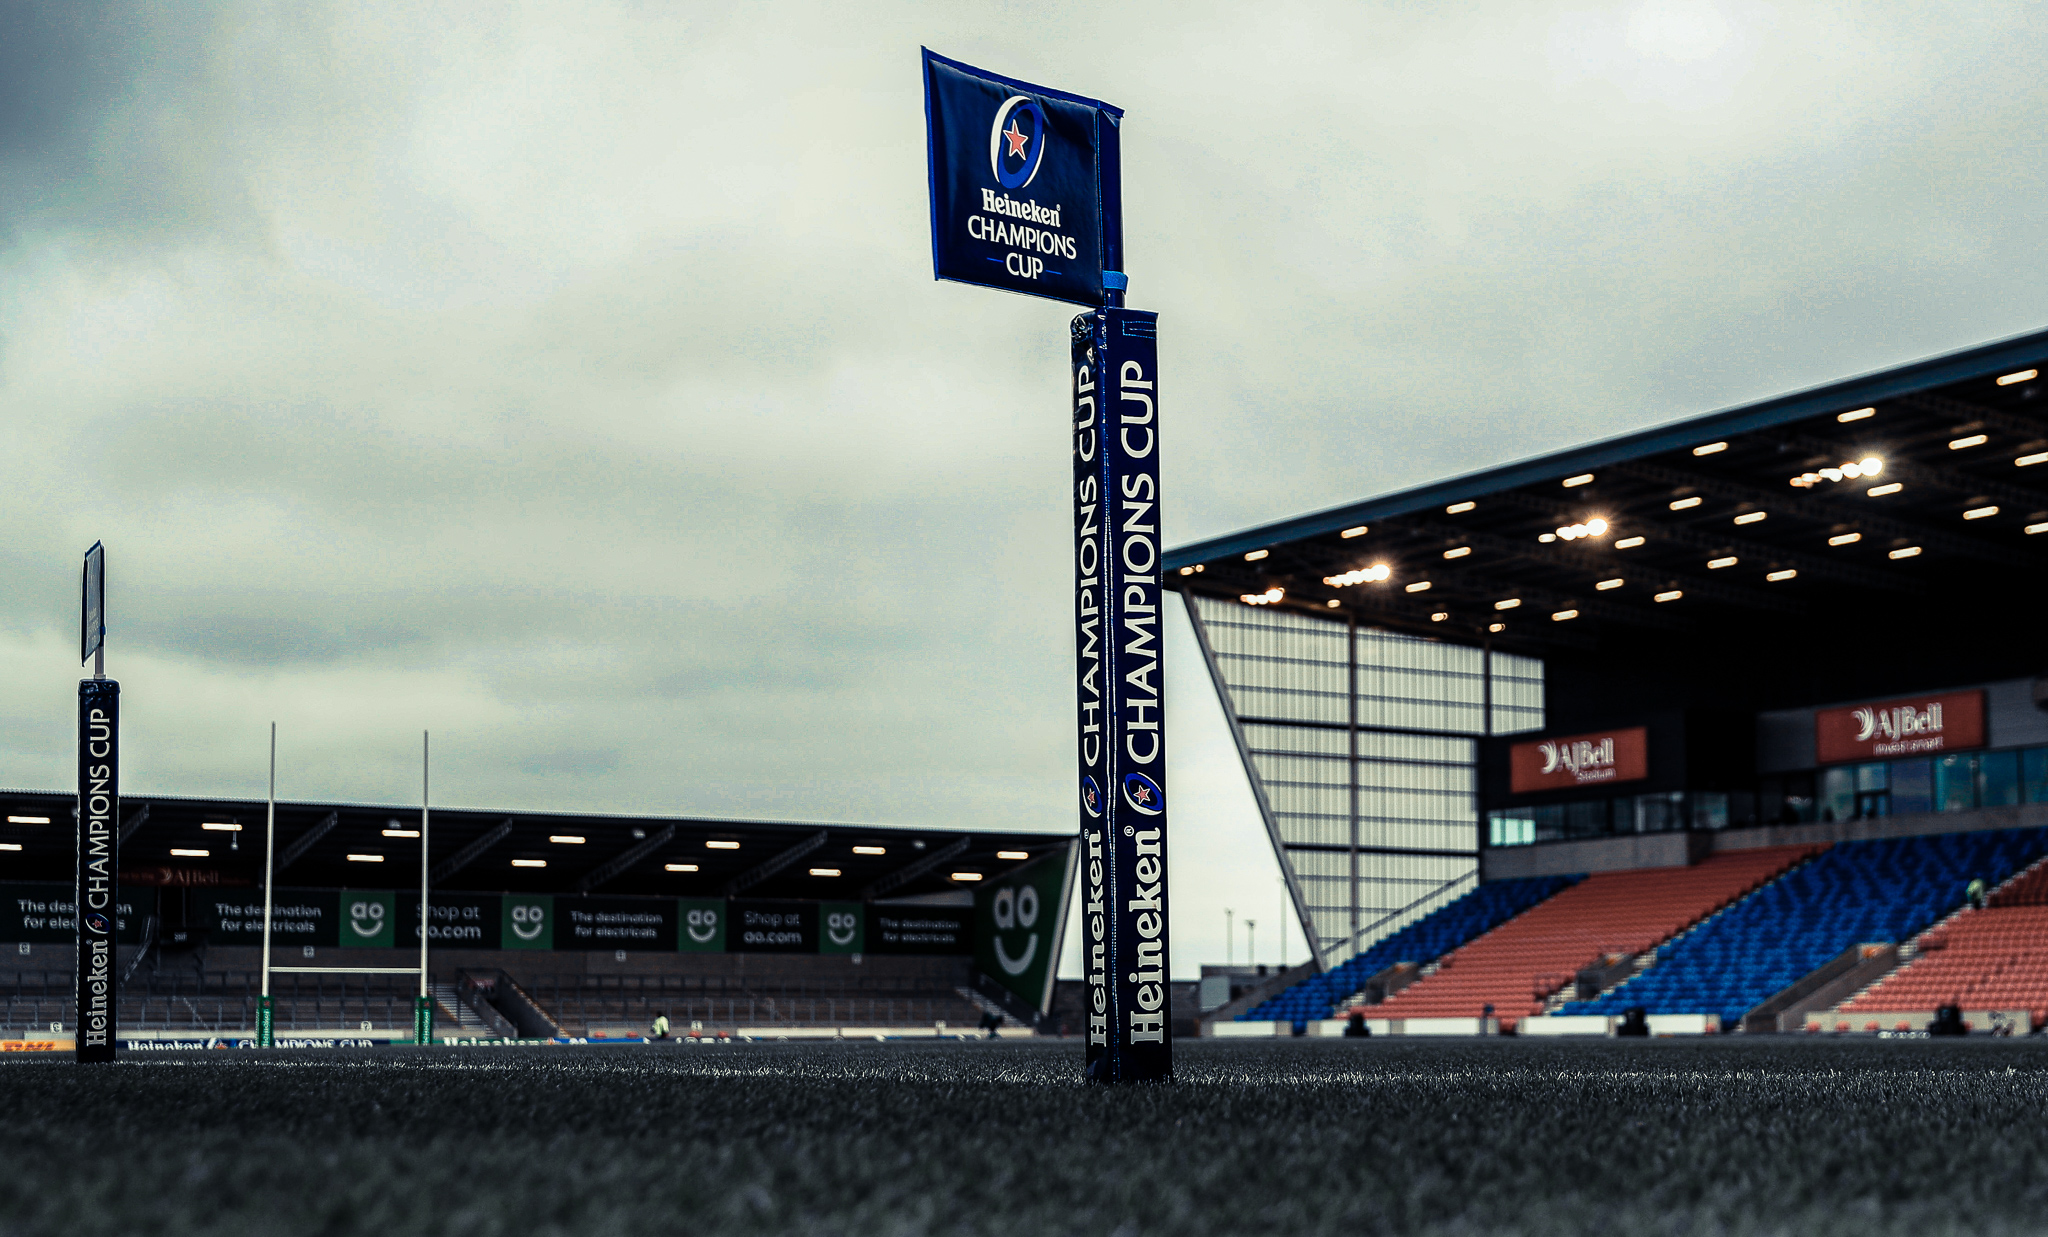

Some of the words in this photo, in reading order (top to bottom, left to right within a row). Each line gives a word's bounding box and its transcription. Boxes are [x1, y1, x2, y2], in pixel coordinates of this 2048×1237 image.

[967, 215, 1077, 260] CHAMPIONS
[1005, 252, 1044, 280] CUP
[1078, 365, 1096, 462] CUP
[1120, 360, 1154, 459] CUP
[1079, 475, 1100, 767] CHAMPIONS
[1121, 473, 1159, 765] CHAMPIONS
[89, 708, 111, 758] CUP
[88, 764, 110, 909] CHAMPIONS
[18, 899, 46, 913] The
[23, 915, 45, 930] for
[215, 903, 242, 916] The
[244, 903, 322, 918] deination
[462, 905, 481, 920] at
[569, 910, 594, 923] The
[743, 910, 783, 928] Shop
[992, 884, 1039, 930] ao
[220, 918, 242, 932] for
[244, 919, 316, 933] eletricals
